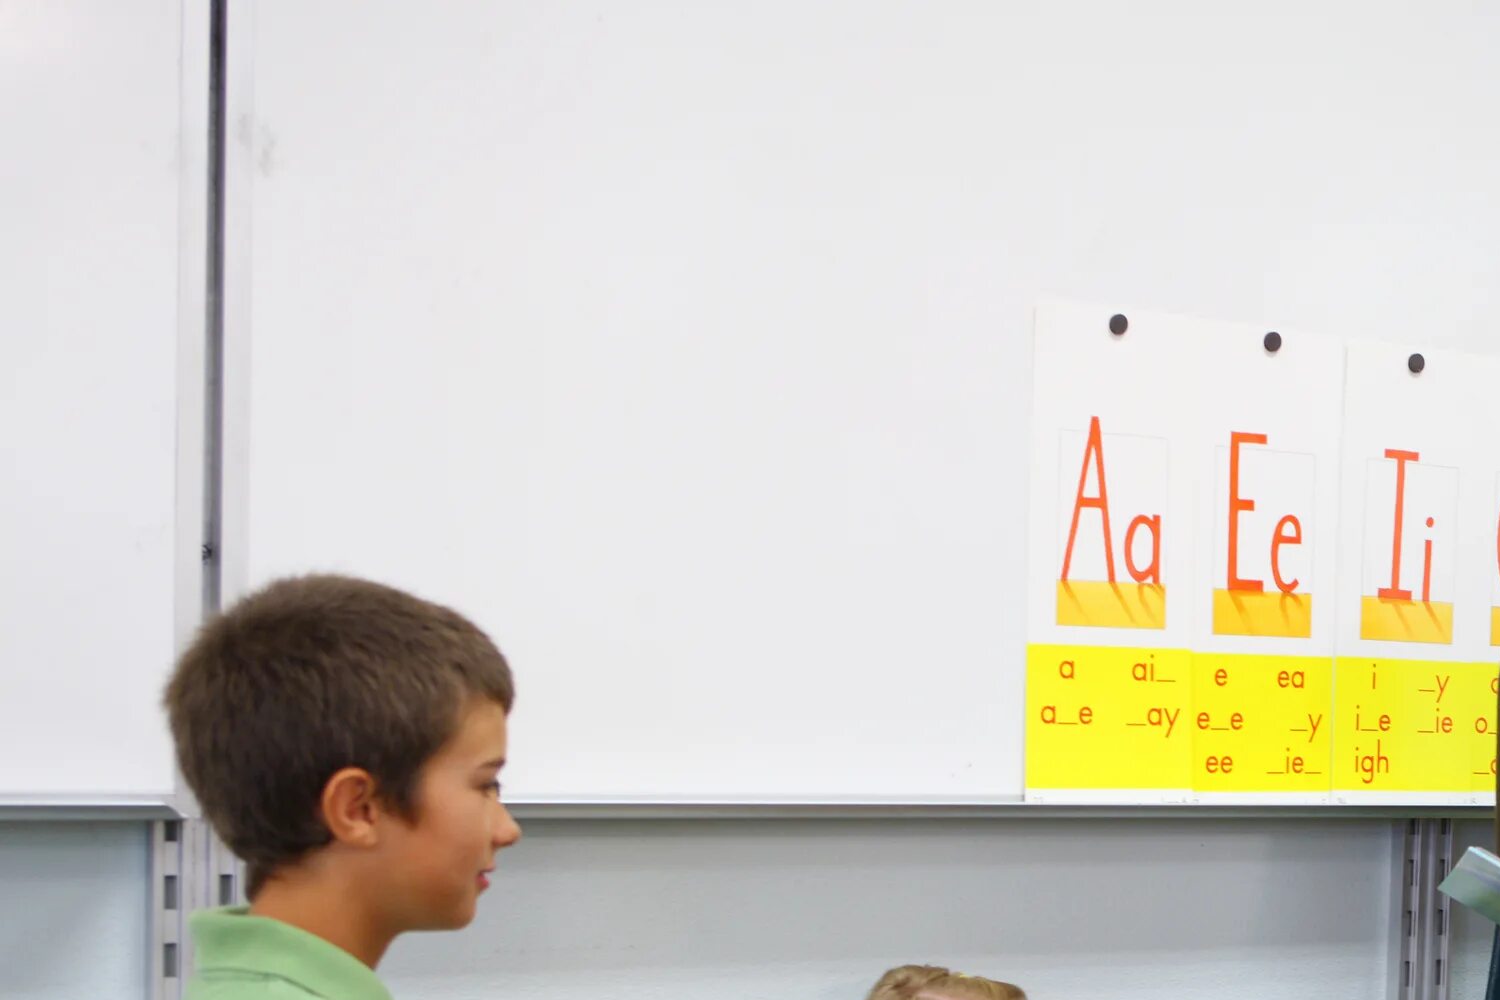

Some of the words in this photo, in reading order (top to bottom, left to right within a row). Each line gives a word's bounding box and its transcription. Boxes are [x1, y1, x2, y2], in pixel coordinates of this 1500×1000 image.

[1061, 416, 1161, 585] Aa
[1227, 431, 1302, 594] Ee
[1378, 449, 1434, 603] Ii
[1059, 661, 1075, 679] a
[1215, 669, 1228, 686] e
[1277, 671, 1305, 688] ea
[1371, 664, 1376, 690] i
[1206, 756, 1233, 774] ee
[1355, 739, 1389, 784] igh
